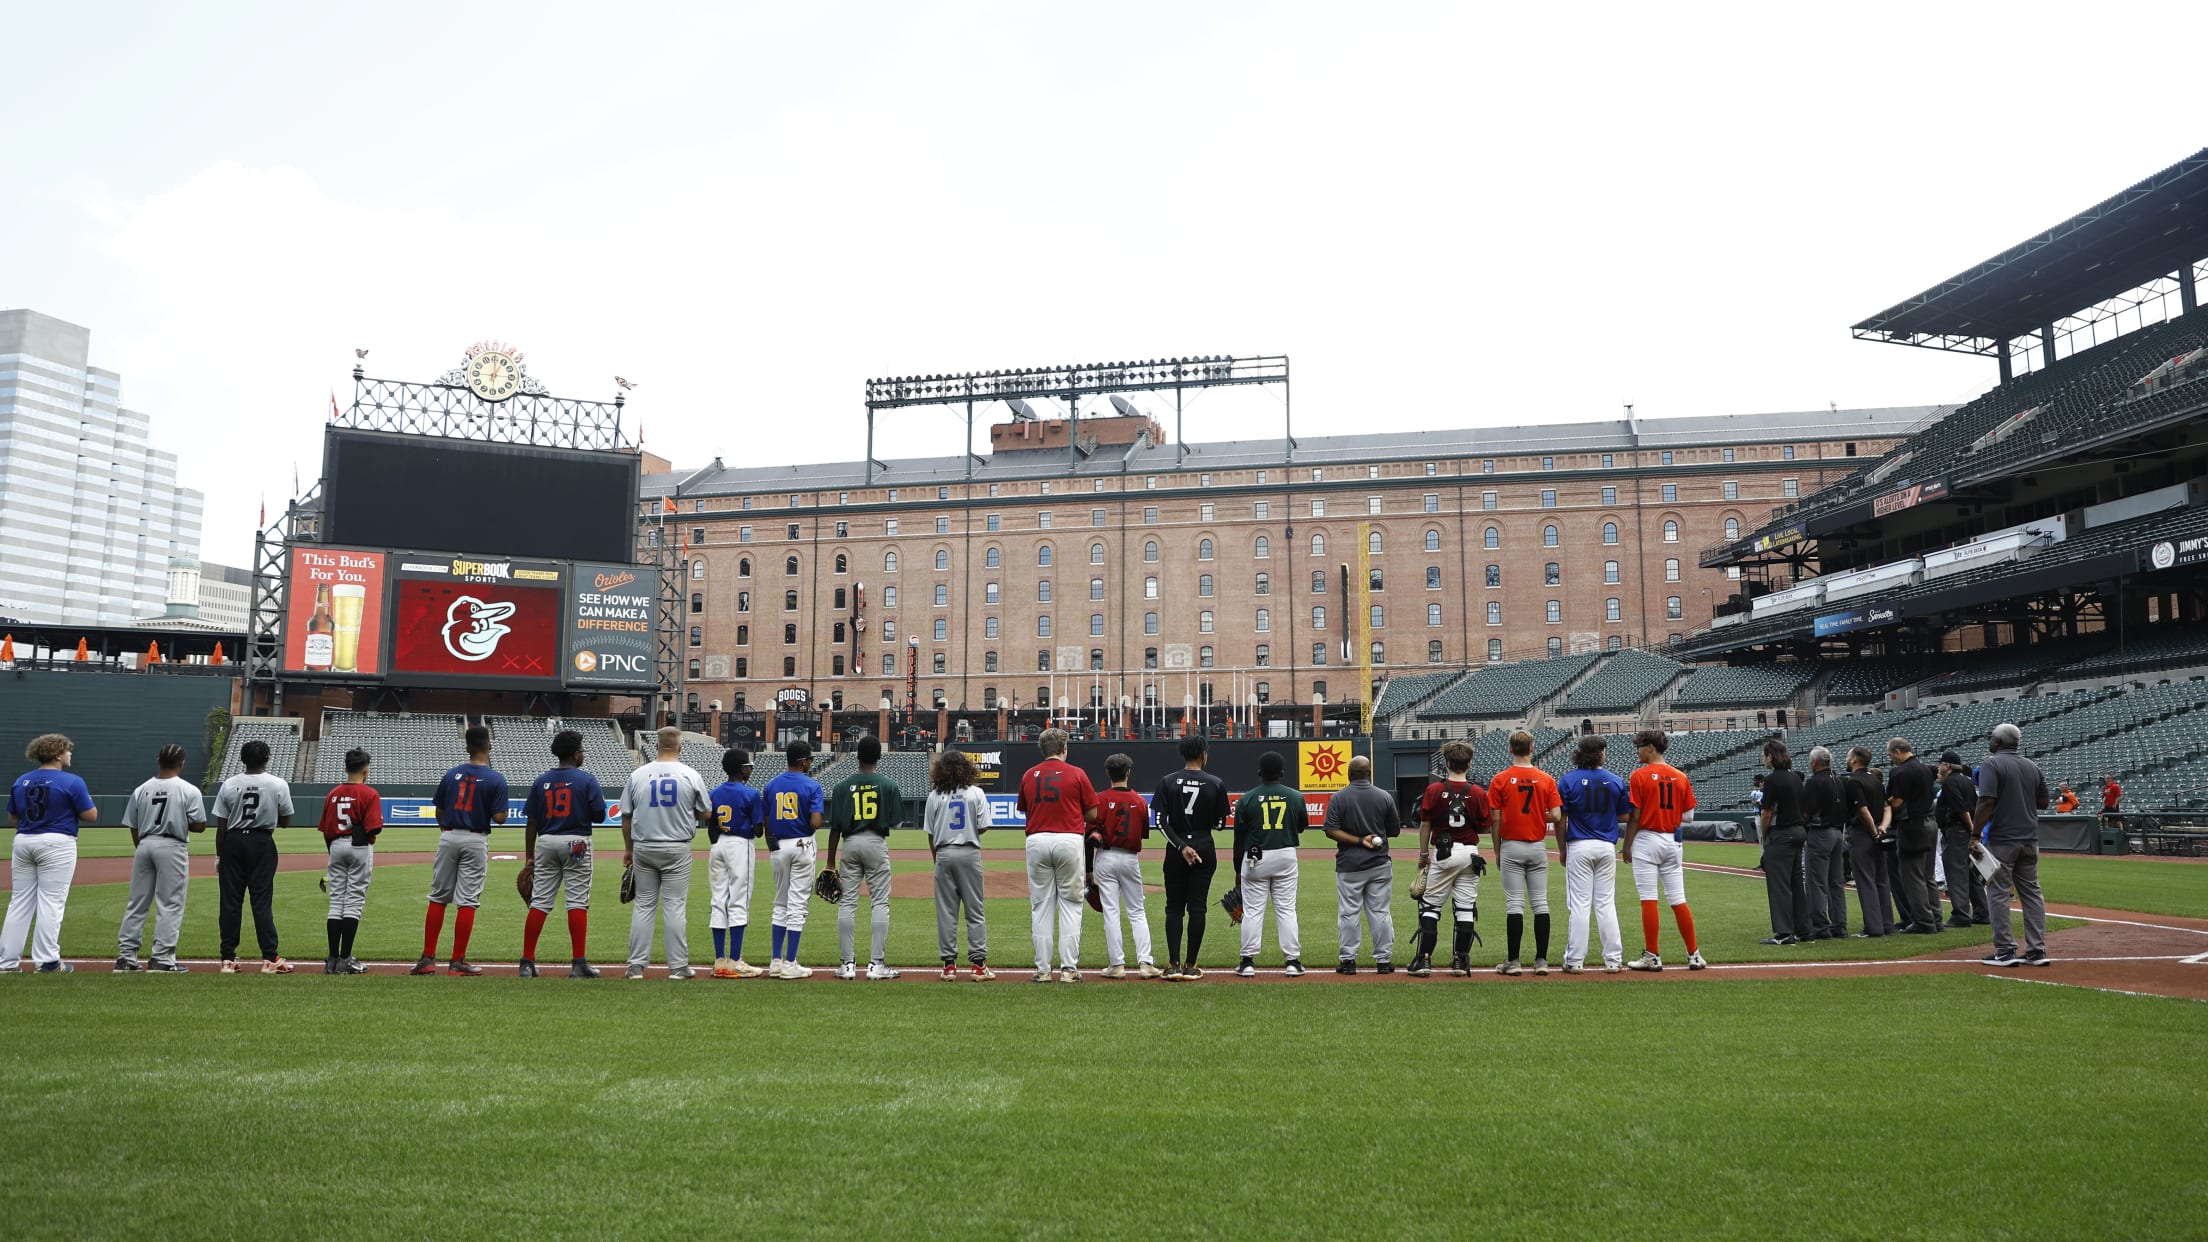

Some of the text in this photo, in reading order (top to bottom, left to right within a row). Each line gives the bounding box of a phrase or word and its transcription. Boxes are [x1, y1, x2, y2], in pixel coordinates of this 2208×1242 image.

[302, 552, 376, 569] This Bud's
[310, 567, 366, 582] For You.
[452, 560, 511, 579] SUPERBOOK
[464, 575, 497, 584] SPORTS
[594, 571, 636, 590] Orioles
[578, 593, 650, 607] SEE HOW WE
[579, 606, 648, 620] CAN MAKE A
[577, 618, 649, 632] DIFFERENCE
[600, 653, 646, 672] PNC
[960, 750, 1003, 765] UPERBOOK
[454, 781, 476, 812] 11
[545, 788, 572, 819] 19
[649, 778, 678, 808] 19
[1034, 775, 1063, 804] 15
[1182, 785, 1200, 815] 7
[1518, 785, 1535, 814] 7
[1658, 781, 1674, 810] 11
[151, 797, 167, 825] 7
[241, 792, 260, 820] 2
[337, 802, 353, 830] 5
[717, 805, 733, 832] 2
[775, 791, 799, 820] 19
[852, 790, 878, 820] 16
[948, 801, 966, 830] 3
[1261, 801, 1287, 830] 17
